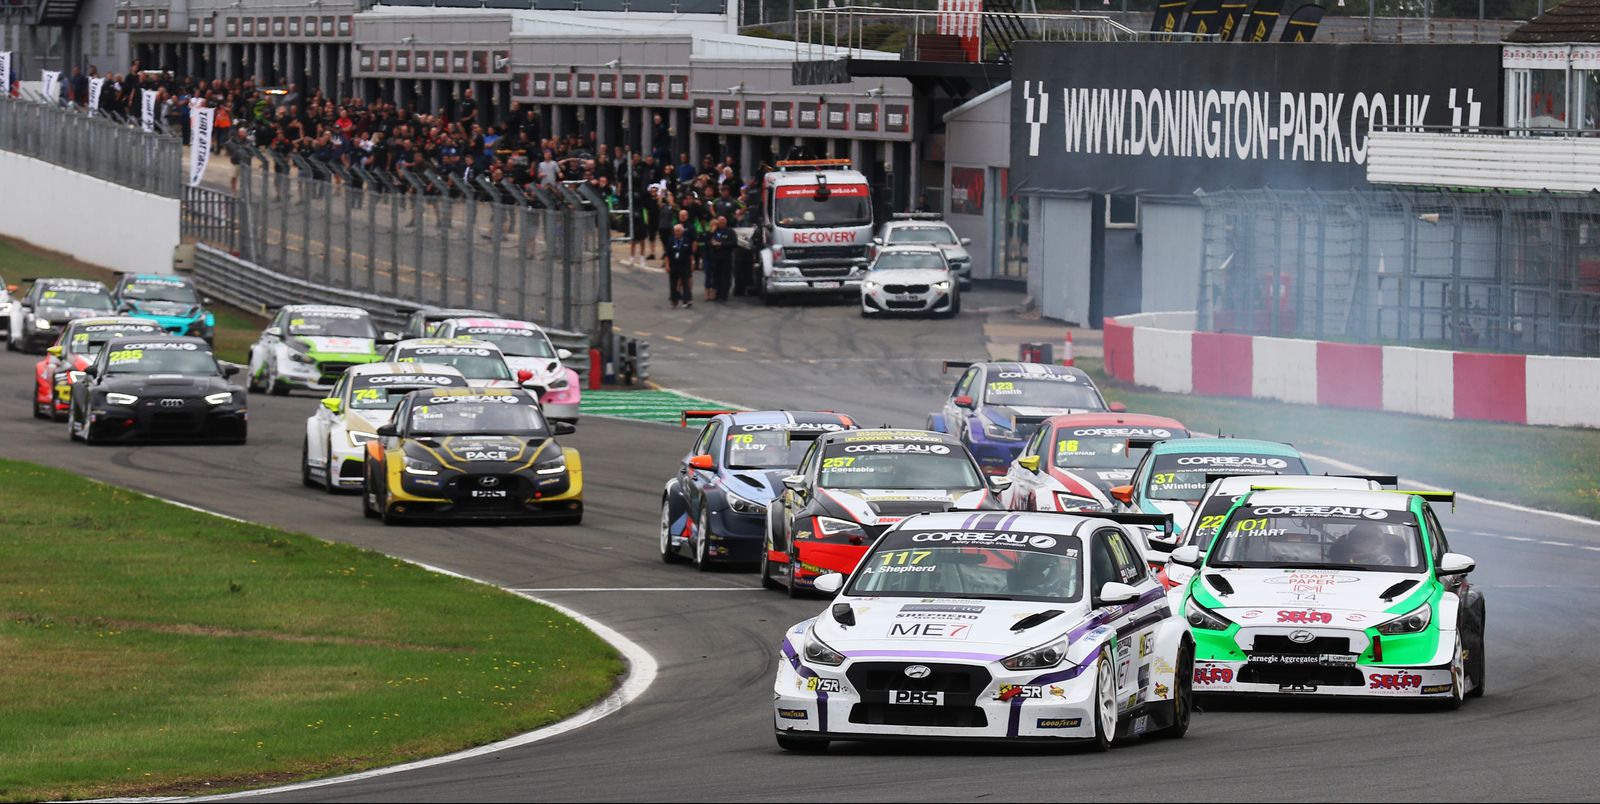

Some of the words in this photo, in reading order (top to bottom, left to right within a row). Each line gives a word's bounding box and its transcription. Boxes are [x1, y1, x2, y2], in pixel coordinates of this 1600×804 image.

[1064, 88, 1431, 165] WWW.DONINGTON-PARK.COUK
[793, 232, 857, 243] RECOVERY
[110, 350, 144, 361] 285
[369, 376, 437, 384] CORBEAU
[999, 372, 1063, 380] CORBEAU
[991, 382, 1014, 390] 123
[353, 389, 378, 400] 74
[430, 396, 502, 404] CORBEAU
[742, 423, 822, 432] CORBEAU
[1074, 428, 1153, 437] CORBEAU
[733, 434, 753, 444] 76
[844, 444, 930, 453] CORBEAU
[1058, 440, 1079, 453] 16
[822, 457, 856, 468] 257
[1177, 456, 1266, 466] CORBEAU
[1154, 473, 1175, 484] 37
[1253, 506, 1363, 516] CORBEAU
[1199, 515, 1226, 528] 22
[1236, 518, 1268, 531] 101
[1196, 528, 1207, 536] C.
[1226, 530, 1243, 539] M.
[912, 532, 1030, 545] CORBEAU
[880, 551, 933, 566] 117
[878, 565, 937, 573] Shepherd
[1277, 609, 1333, 624] SELCO
[890, 623, 969, 637] ME7
[1248, 654, 1278, 664] Carnegie
[1280, 655, 1318, 664] Aggregates
[1193, 667, 1234, 684] ELCO
[1369, 673, 1422, 689] SELCO
[817, 679, 839, 692] YSR
[1012, 686, 1041, 697] SR
[1040, 720, 1079, 728] GOODYEAR
